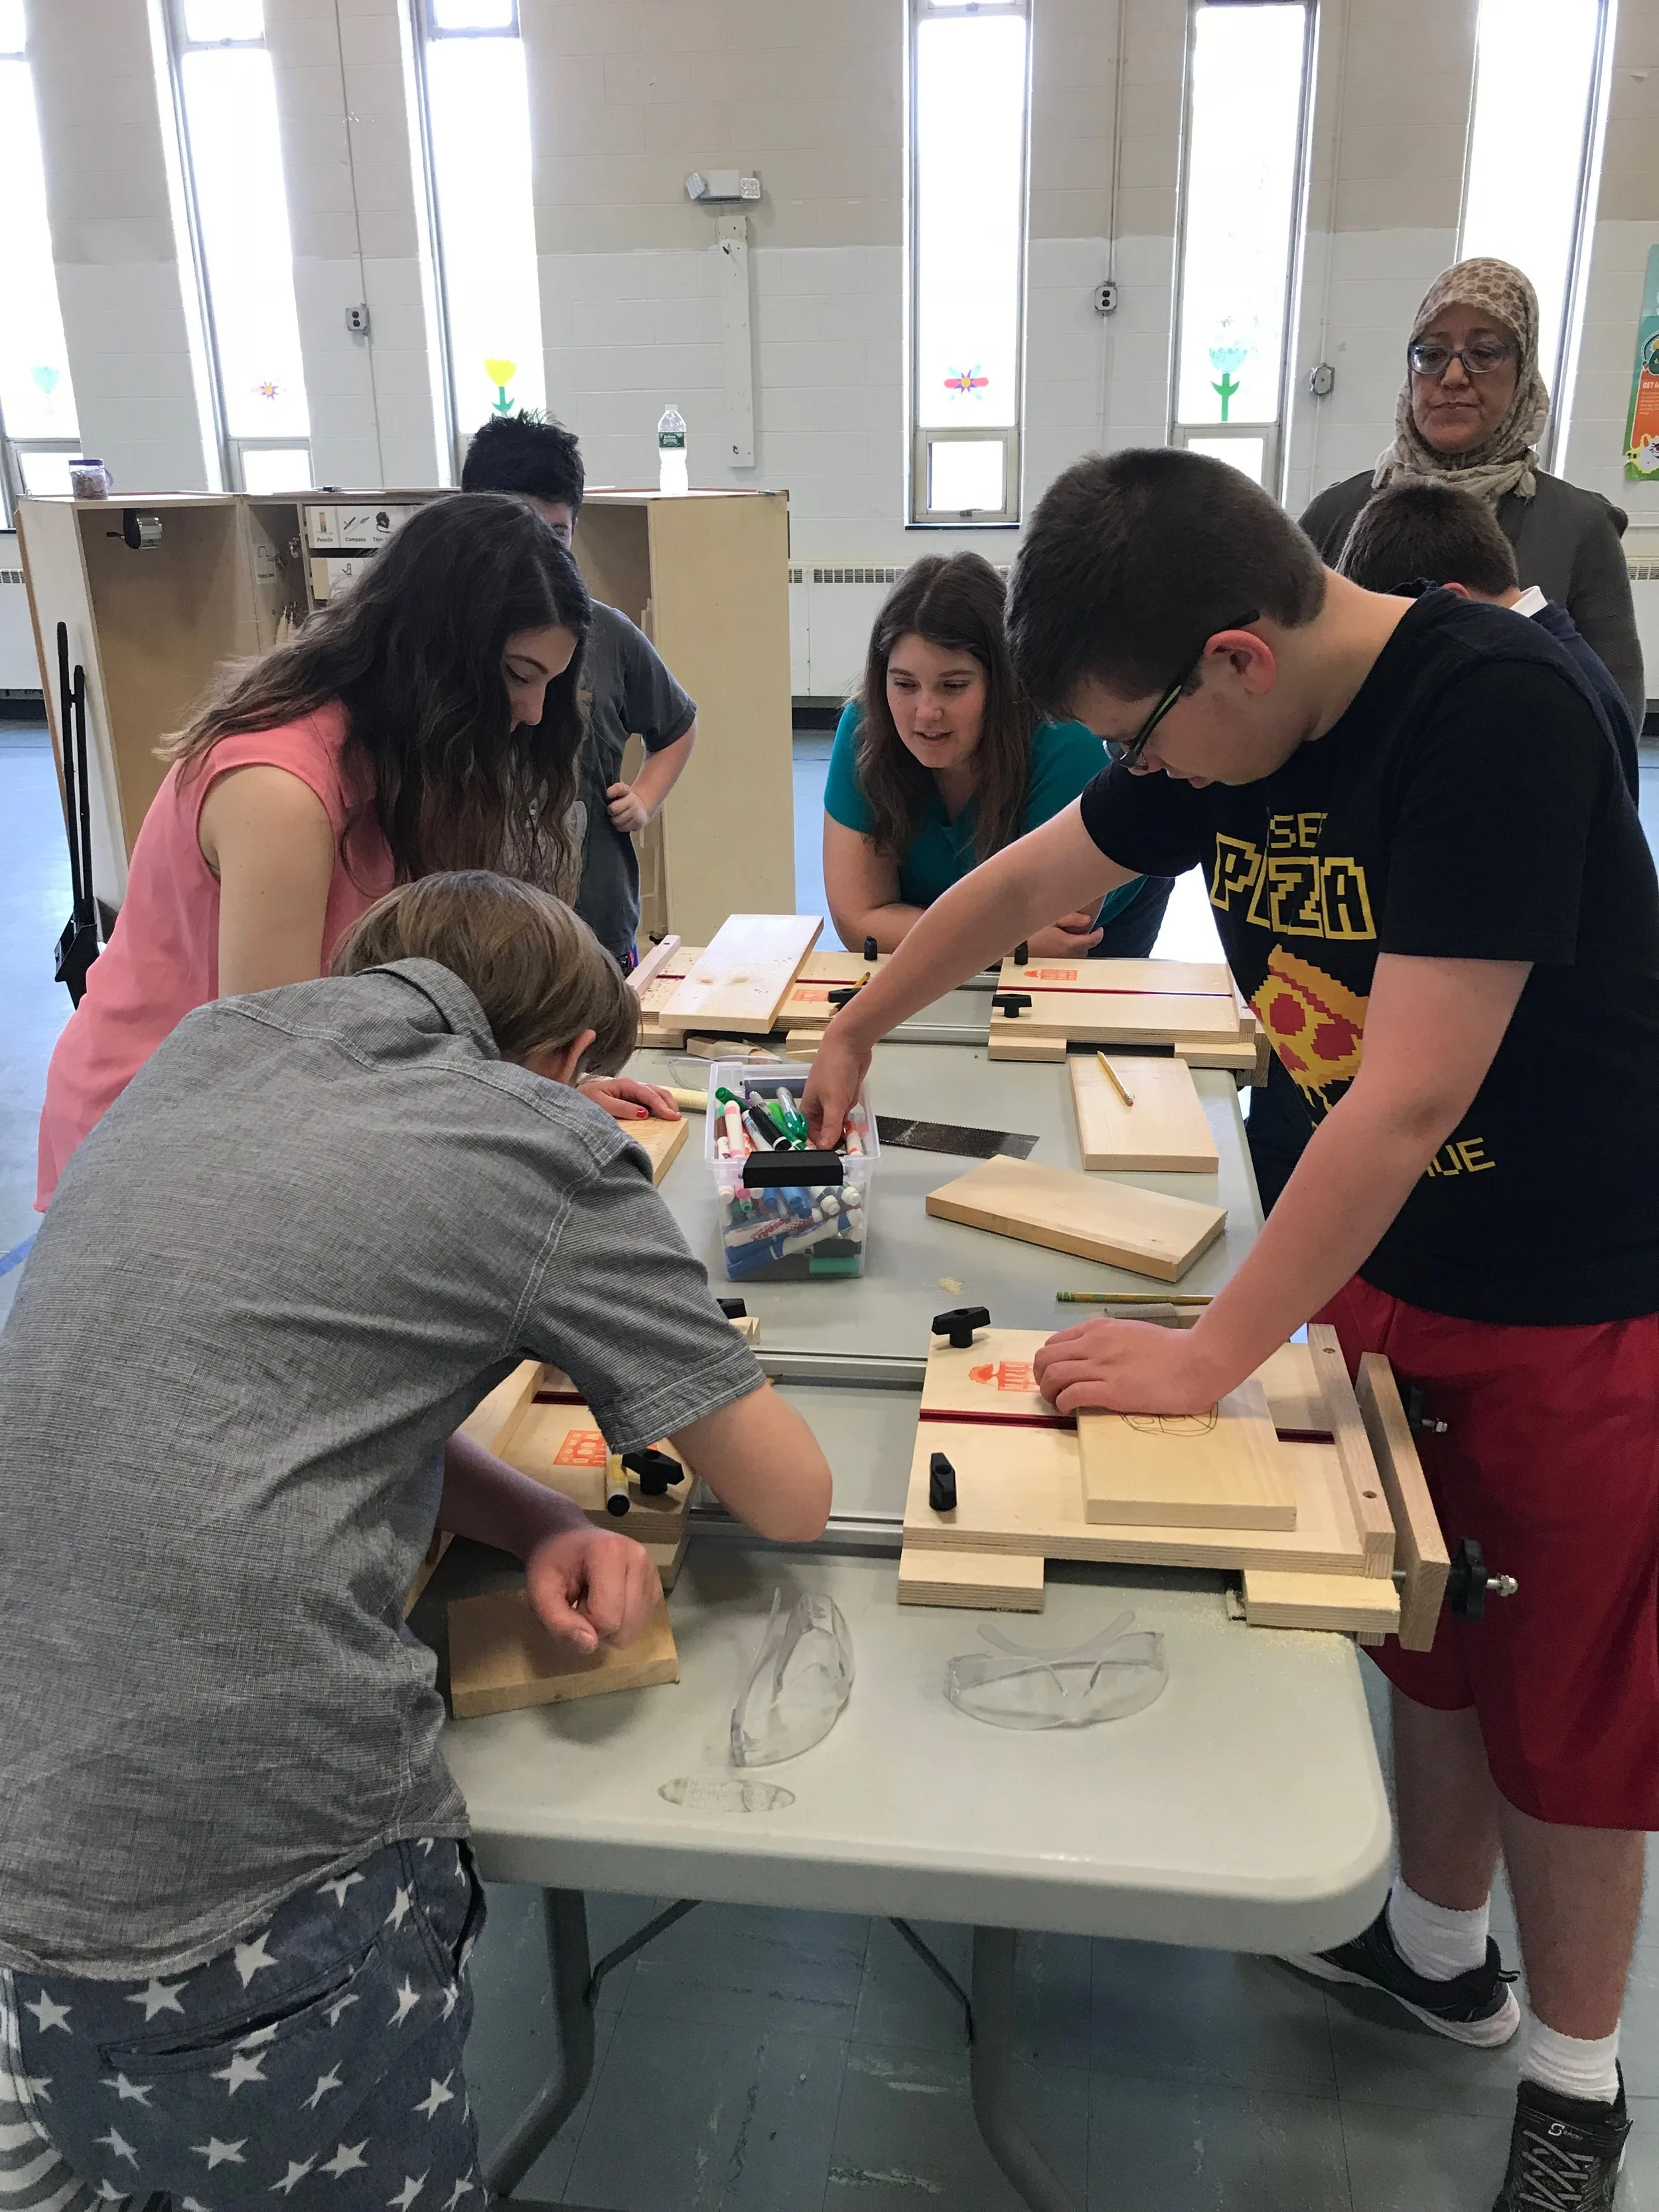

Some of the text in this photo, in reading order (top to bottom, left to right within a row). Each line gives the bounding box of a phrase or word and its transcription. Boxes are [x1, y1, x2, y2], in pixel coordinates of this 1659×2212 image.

[1427, 1137, 1496, 1177] UE
[561, 1432, 582, 1463] SHOP
[572, 1433, 602, 1463] WOOD
